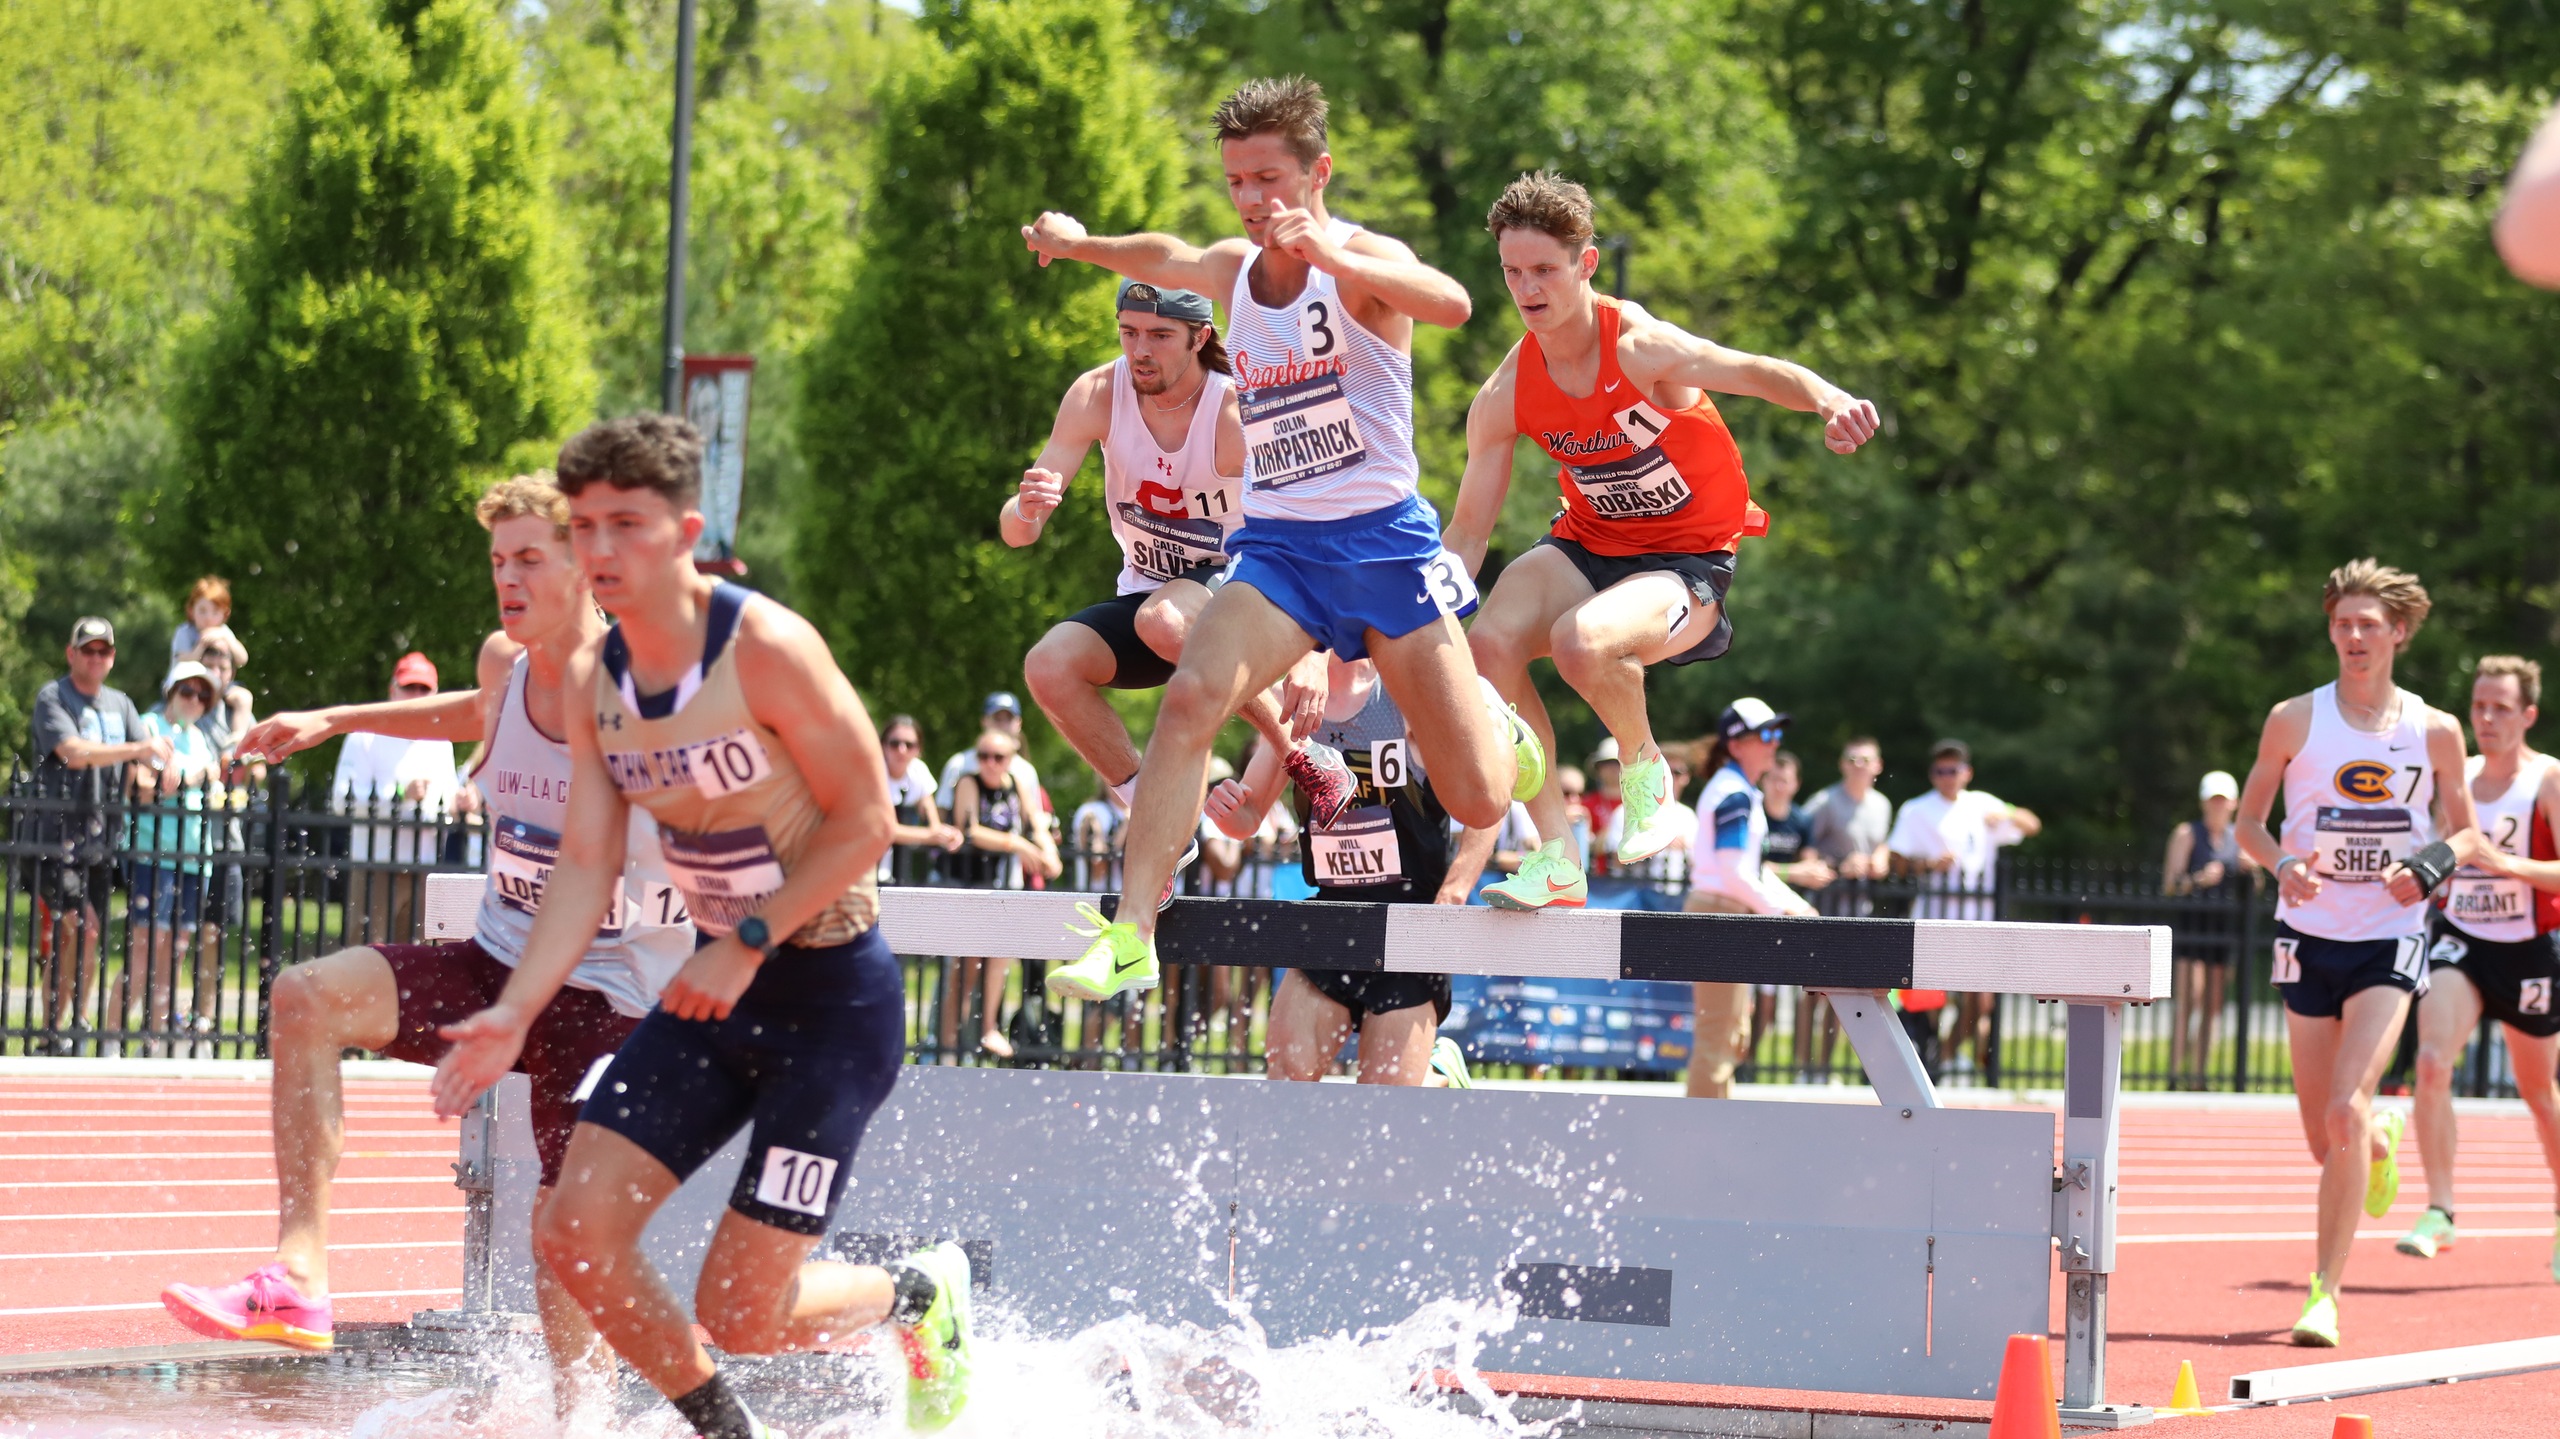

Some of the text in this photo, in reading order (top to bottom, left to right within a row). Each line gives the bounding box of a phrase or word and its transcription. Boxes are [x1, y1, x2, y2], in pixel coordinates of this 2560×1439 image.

[1307, 301, 1335, 357] 3
[1250, 404, 1266, 416] TRACK
[1269, 399, 1285, 410] FIELD
[1286, 383, 1338, 405] CHAMPIONSHIPS
[1273, 414, 1307, 435] COLIN
[1628, 409, 1661, 436] 1
[1252, 418, 1359, 477] KIRKPATRICK
[1600, 472, 1617, 480] FIELD
[1617, 455, 1664, 476] CHAMPIONSHIPS
[1584, 477, 1685, 513] SOBASKI
[1604, 481, 1641, 493] LANCE
[1195, 489, 1228, 517] 11
[1134, 516, 1150, 529] TRACK
[1154, 524, 1170, 535] FIELD
[1170, 528, 1219, 545] CHAMPIONSHIPS
[1153, 538, 1185, 556] CALEB
[1432, 561, 1463, 609] 3
[703, 742, 754, 791] 10
[1380, 742, 1400, 784] 6
[498, 770, 551, 801] UW-LA
[2405, 766, 2422, 803] 7
[512, 839, 534, 854] TRACK
[1338, 839, 1360, 850] WILL
[2346, 837, 2382, 847] MASON
[2499, 817, 2518, 848] 2
[1326, 848, 1384, 876] KELLY
[2334, 848, 2392, 872] SHEA
[2455, 893, 2517, 913] BRIANT
[2406, 936, 2420, 971] 7
[2528, 983, 2542, 1010] 2
[782, 1155, 822, 1207] 10
